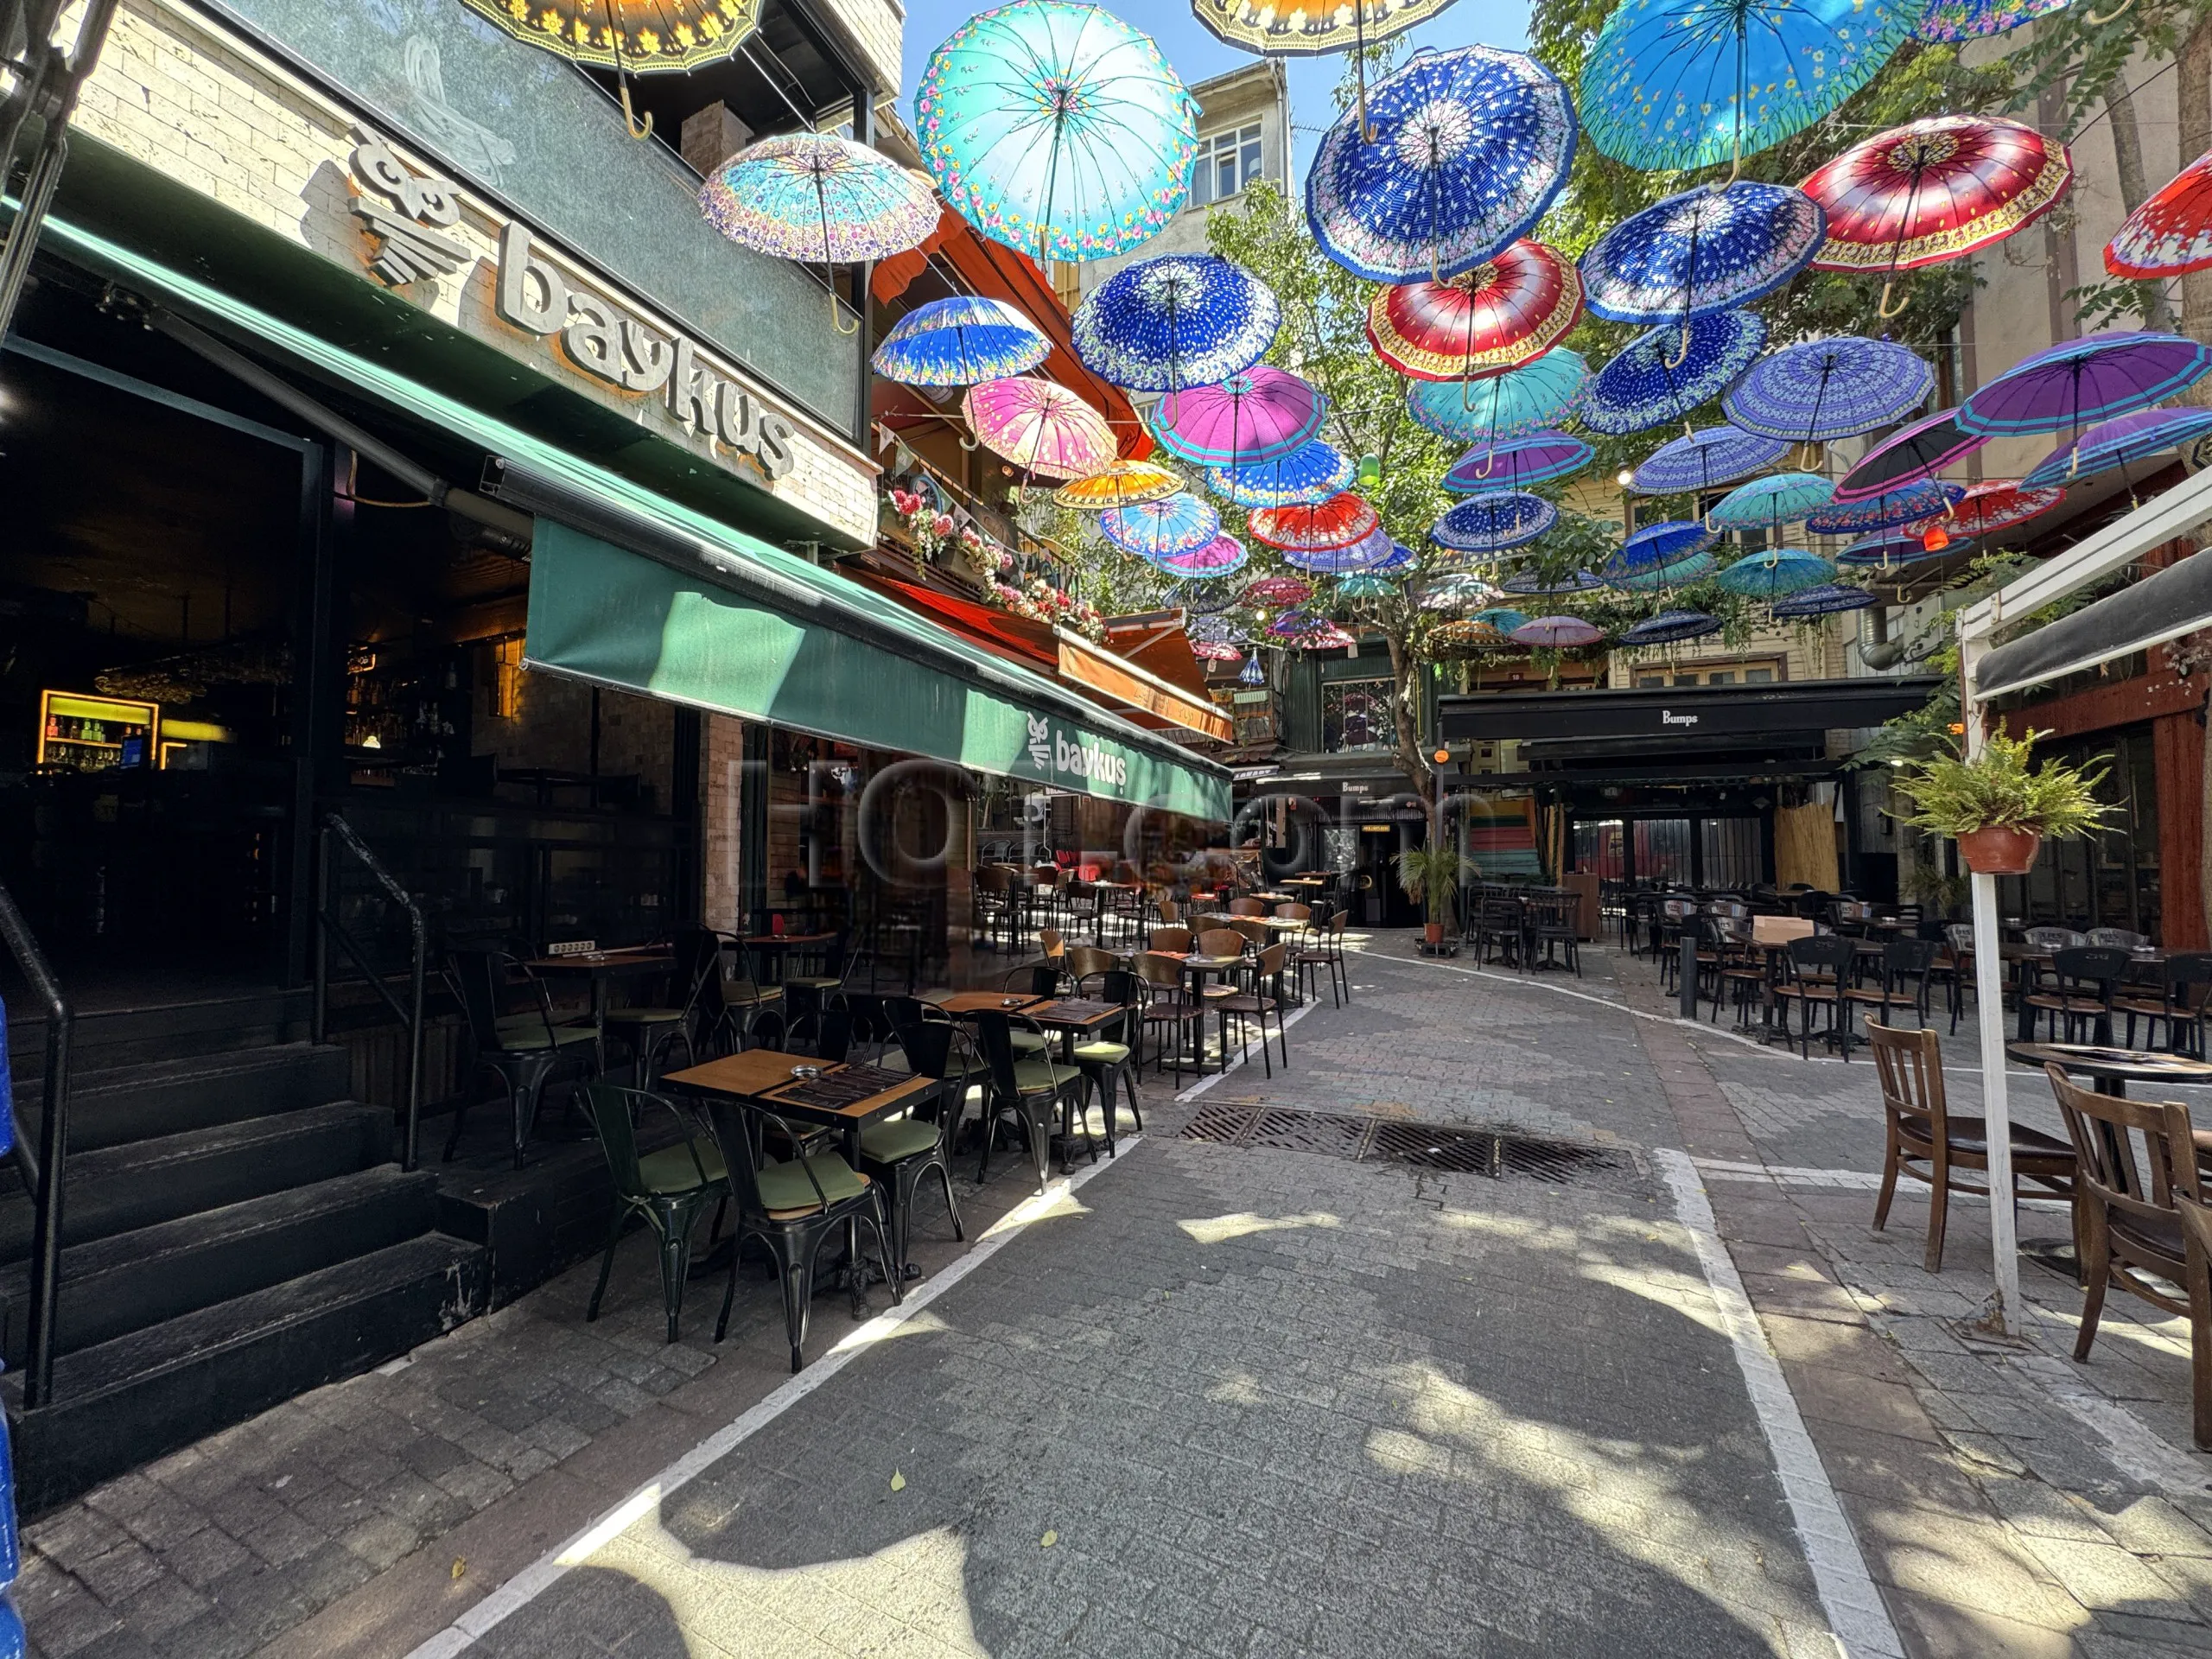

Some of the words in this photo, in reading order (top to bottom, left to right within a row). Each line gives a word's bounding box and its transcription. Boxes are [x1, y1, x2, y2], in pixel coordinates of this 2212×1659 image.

[494, 220, 794, 481] baykuş
[1662, 709, 1699, 727] Bumps
[1056, 729, 1127, 795] baykuş
[1342, 781, 1369, 794] Bumps
